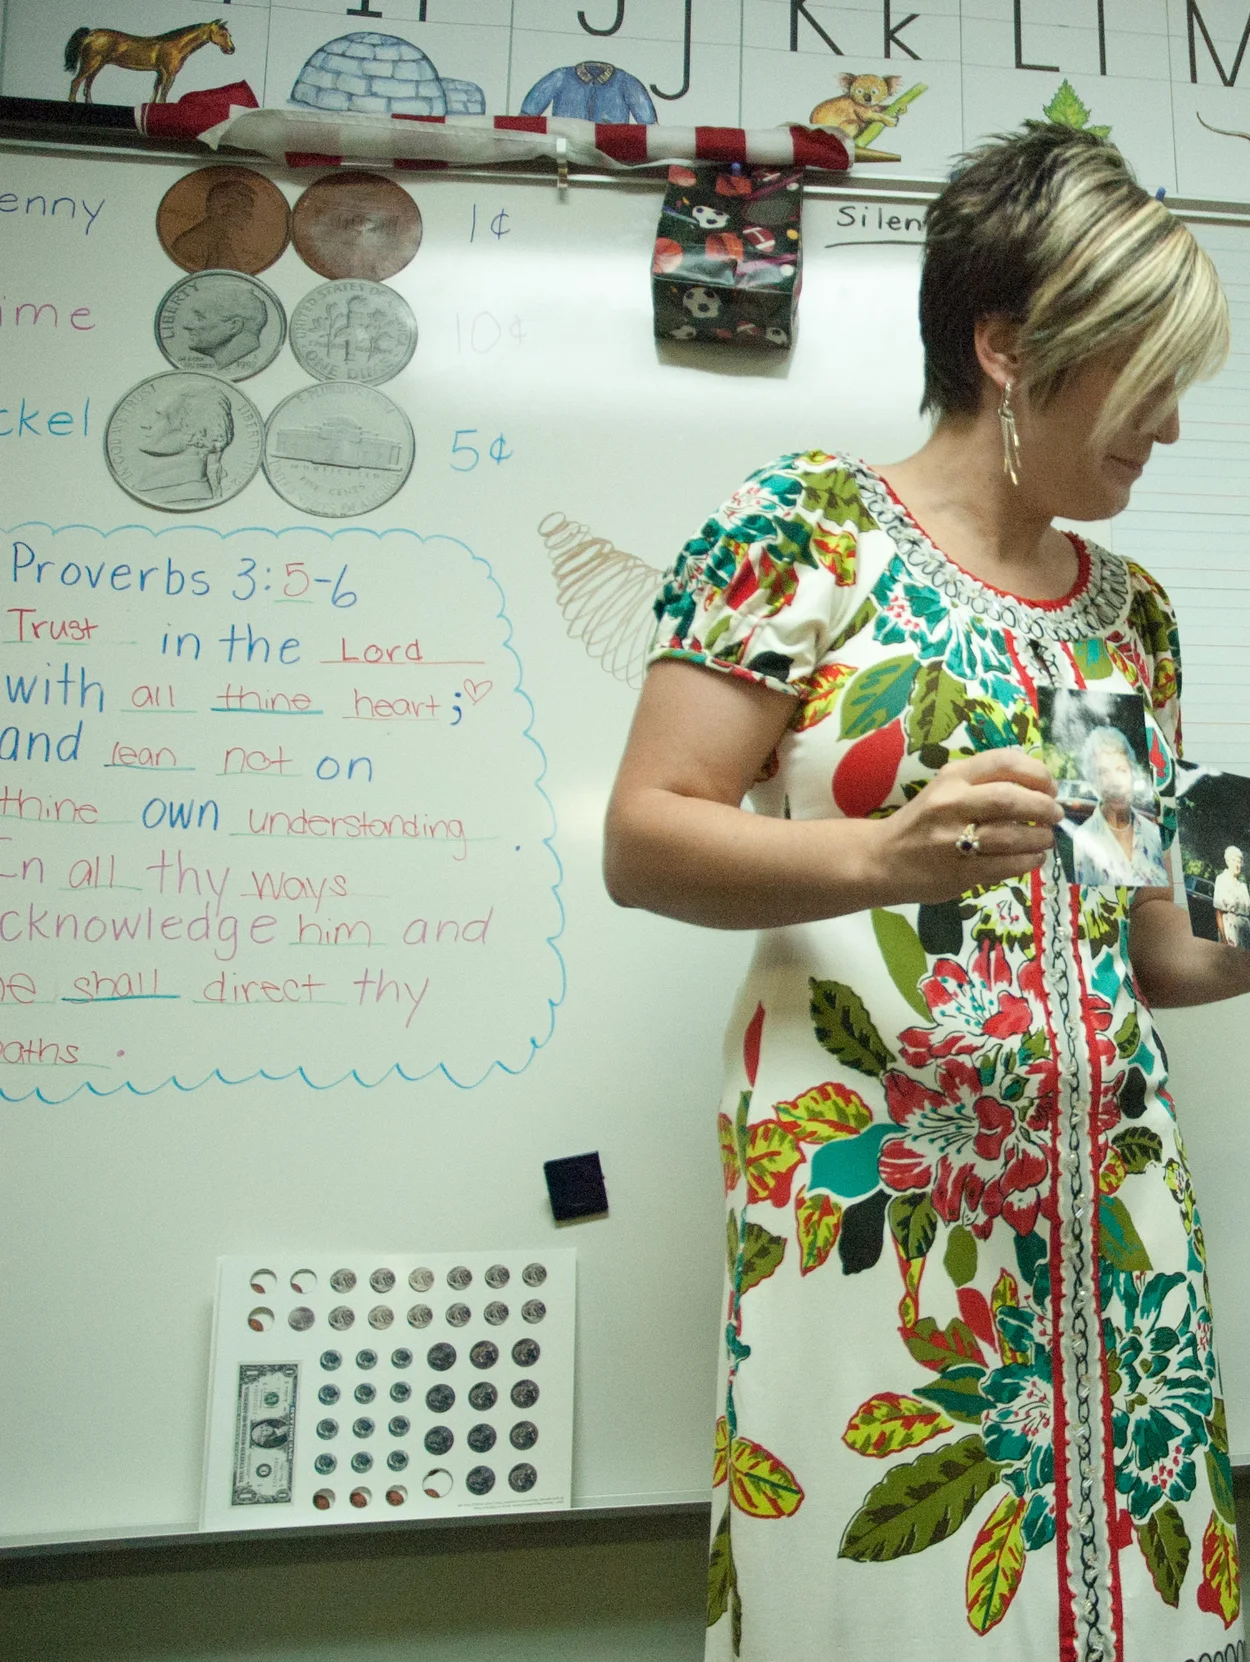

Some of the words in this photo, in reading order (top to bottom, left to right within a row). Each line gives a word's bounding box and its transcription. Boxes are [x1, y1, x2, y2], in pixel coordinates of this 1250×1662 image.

[0, 193, 105, 235] enny
[469, 202, 512, 243] 1¢
[449, 427, 514, 471] 5¢
[10, 541, 211, 598] Proverbs
[231, 556, 358, 609] 3:5-6
[7, 607, 99, 642] Trust
[161, 622, 202, 661] in
[218, 623, 301, 665] the
[340, 635, 424, 664] Lord
[6, 662, 105, 713] with
[131, 683, 177, 709] all
[217, 683, 312, 712] thine
[0, 720, 84, 763] and
[110, 740, 178, 769] lean
[223, 745, 293, 774] not
[315, 755, 373, 783] on
[0, 785, 99, 825] thine
[141, 797, 220, 832] own
[248, 808, 468, 861] understanding
[68, 854, 116, 889] all
[145, 849, 231, 917] thy
[0, 901, 279, 962] cknowledge
[298, 913, 373, 948] him
[402, 905, 495, 946] and
[0, 972, 37, 1005] e
[73, 970, 161, 1004] shall
[202, 971, 327, 1004] direct
[353, 967, 430, 1028] thy
[0, 1037, 79, 1065] aths
